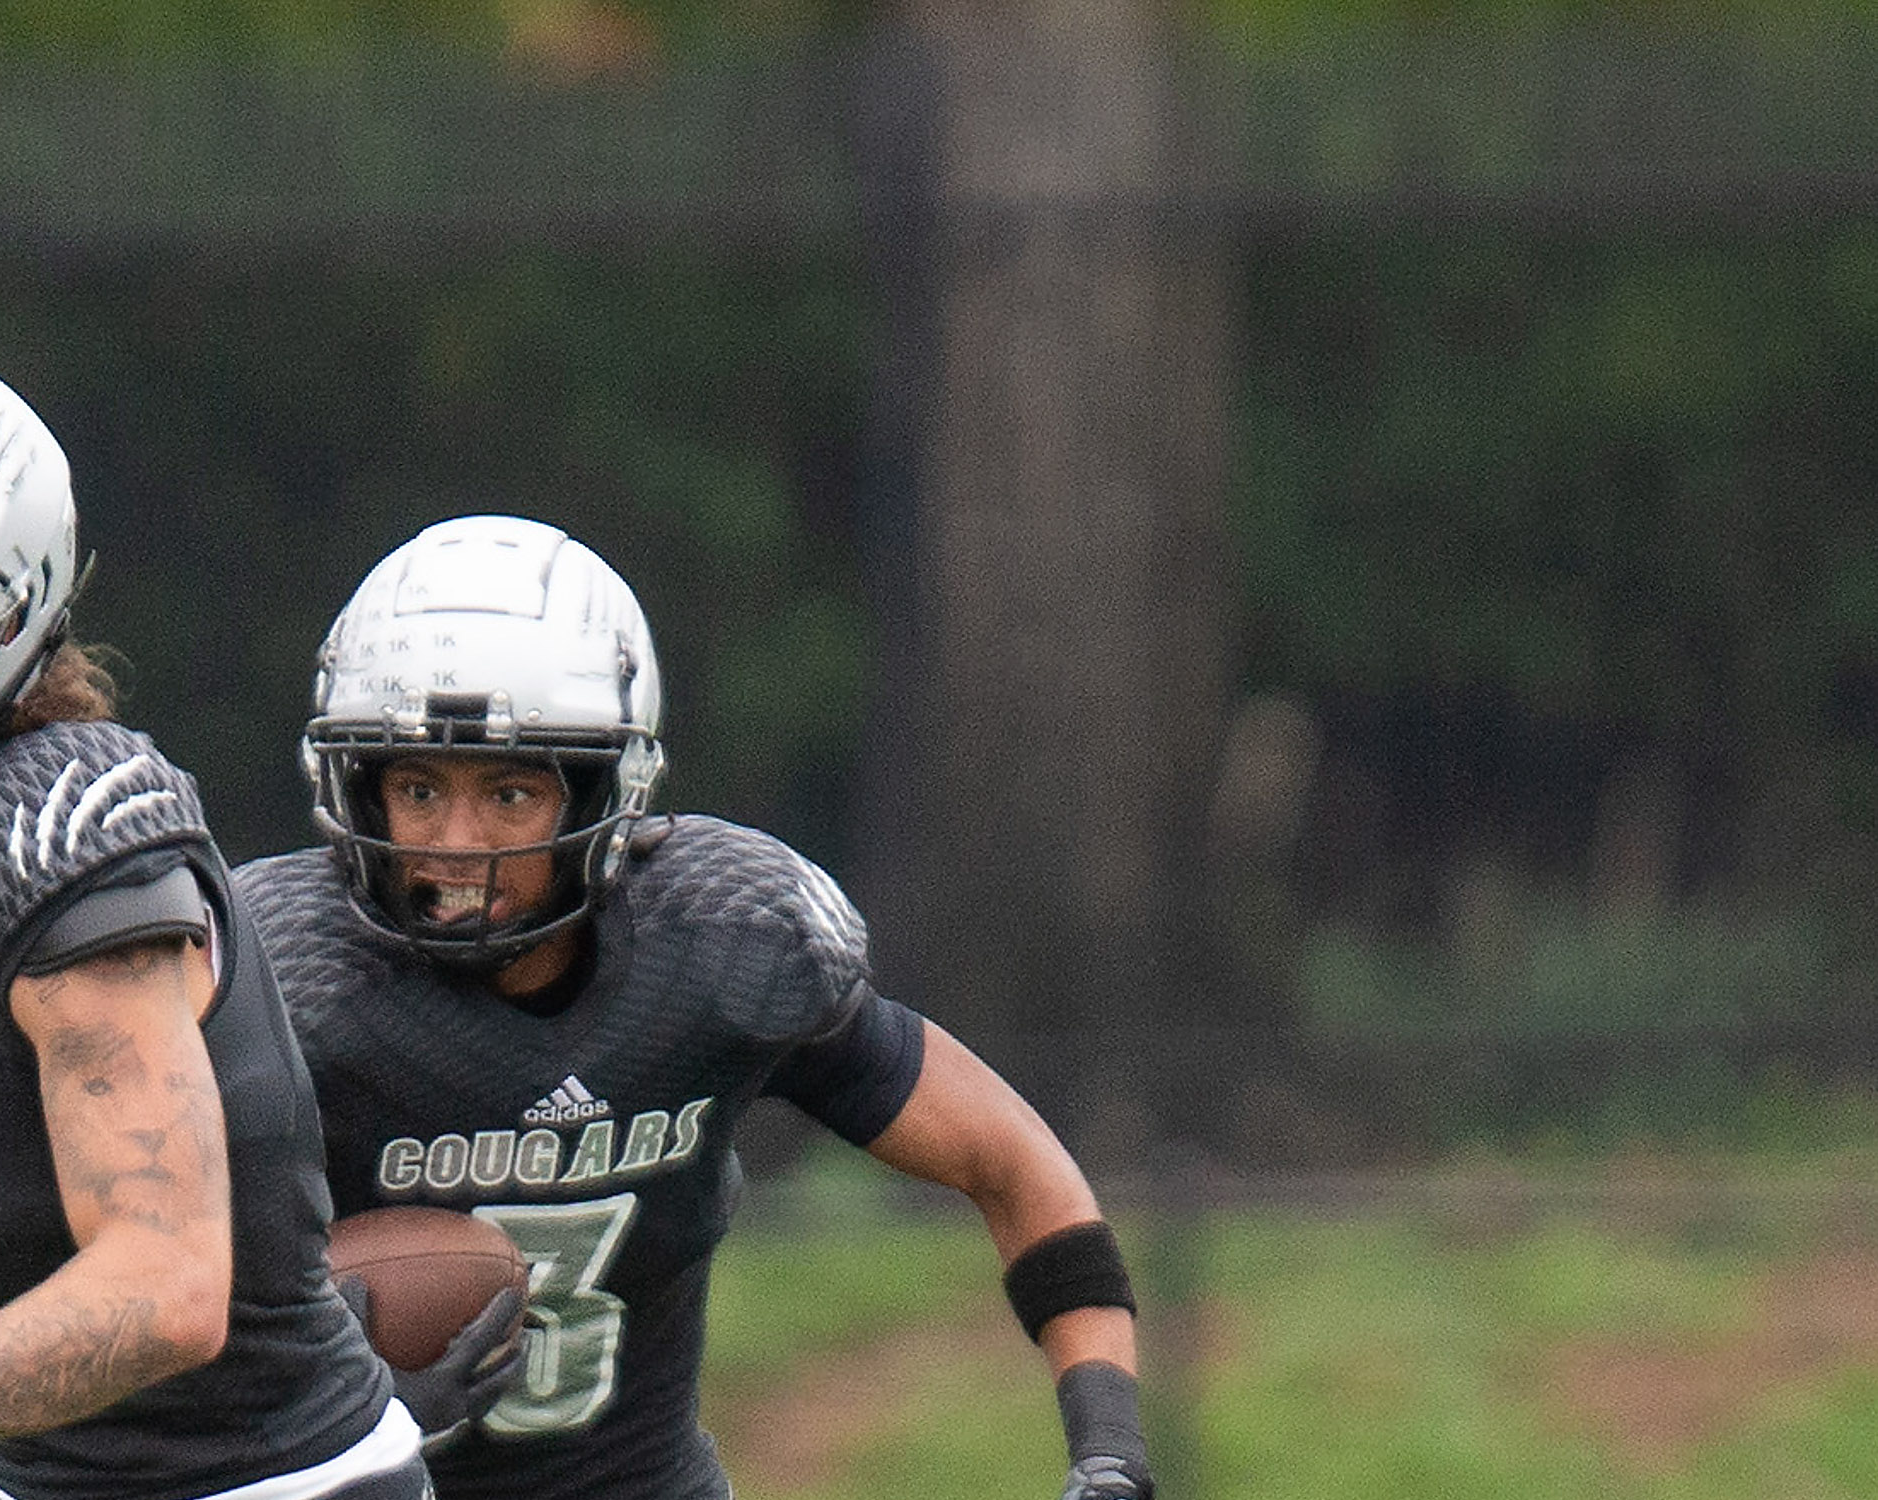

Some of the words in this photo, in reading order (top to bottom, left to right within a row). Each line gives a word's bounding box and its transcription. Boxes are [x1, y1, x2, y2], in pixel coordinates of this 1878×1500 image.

[388, 636, 410, 654] 1K
[433, 633, 457, 648] 1K
[431, 668, 457, 688] 1K
[523, 1099, 609, 1123] adidas
[379, 1097, 714, 1190] COUGARS
[471, 1191, 638, 1434] 3
